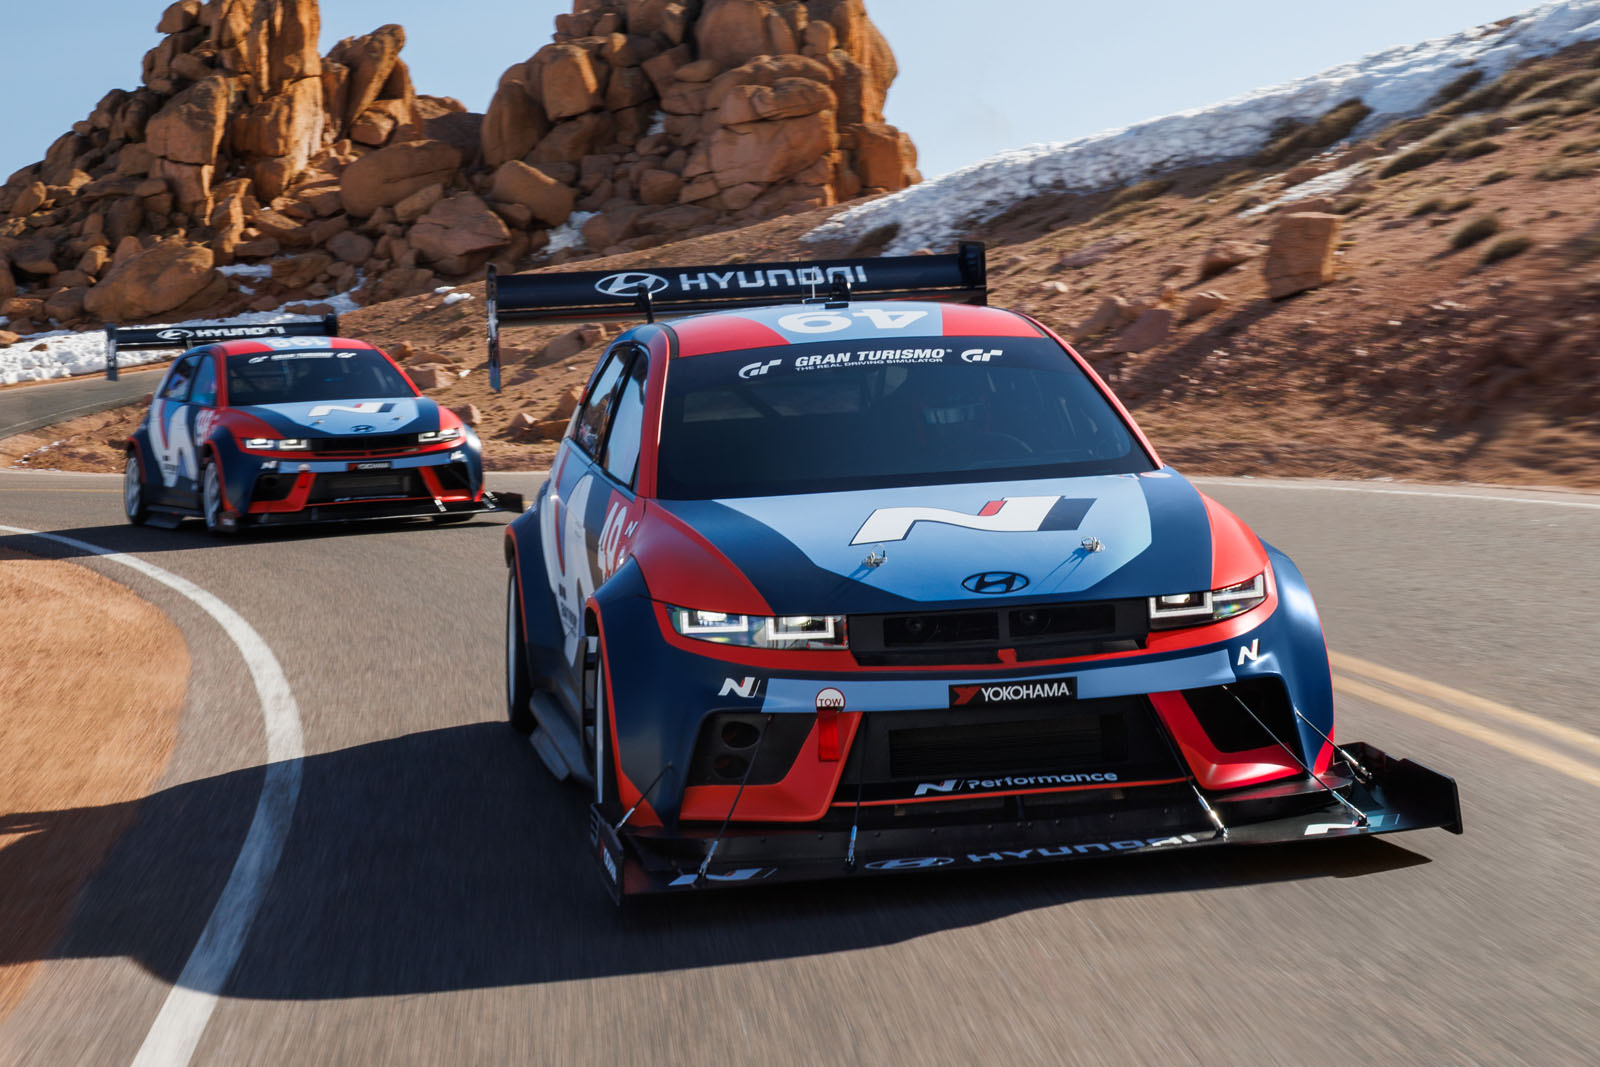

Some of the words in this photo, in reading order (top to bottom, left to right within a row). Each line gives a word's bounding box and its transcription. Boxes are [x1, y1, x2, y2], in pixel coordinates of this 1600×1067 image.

[678, 265, 868, 291] HYUNDAI
[795, 352, 851, 367] GRAN
[857, 348, 945, 362] TURISMO
[795, 364, 815, 372] THE
[817, 362, 843, 370] REAL
[844, 359, 884, 367] DRIVING
[981, 682, 1071, 702] YOKOHAMA
[818, 698, 842, 707] TOW
[966, 772, 1119, 790] Performance
[966, 833, 1197, 862] HYUNDAI
